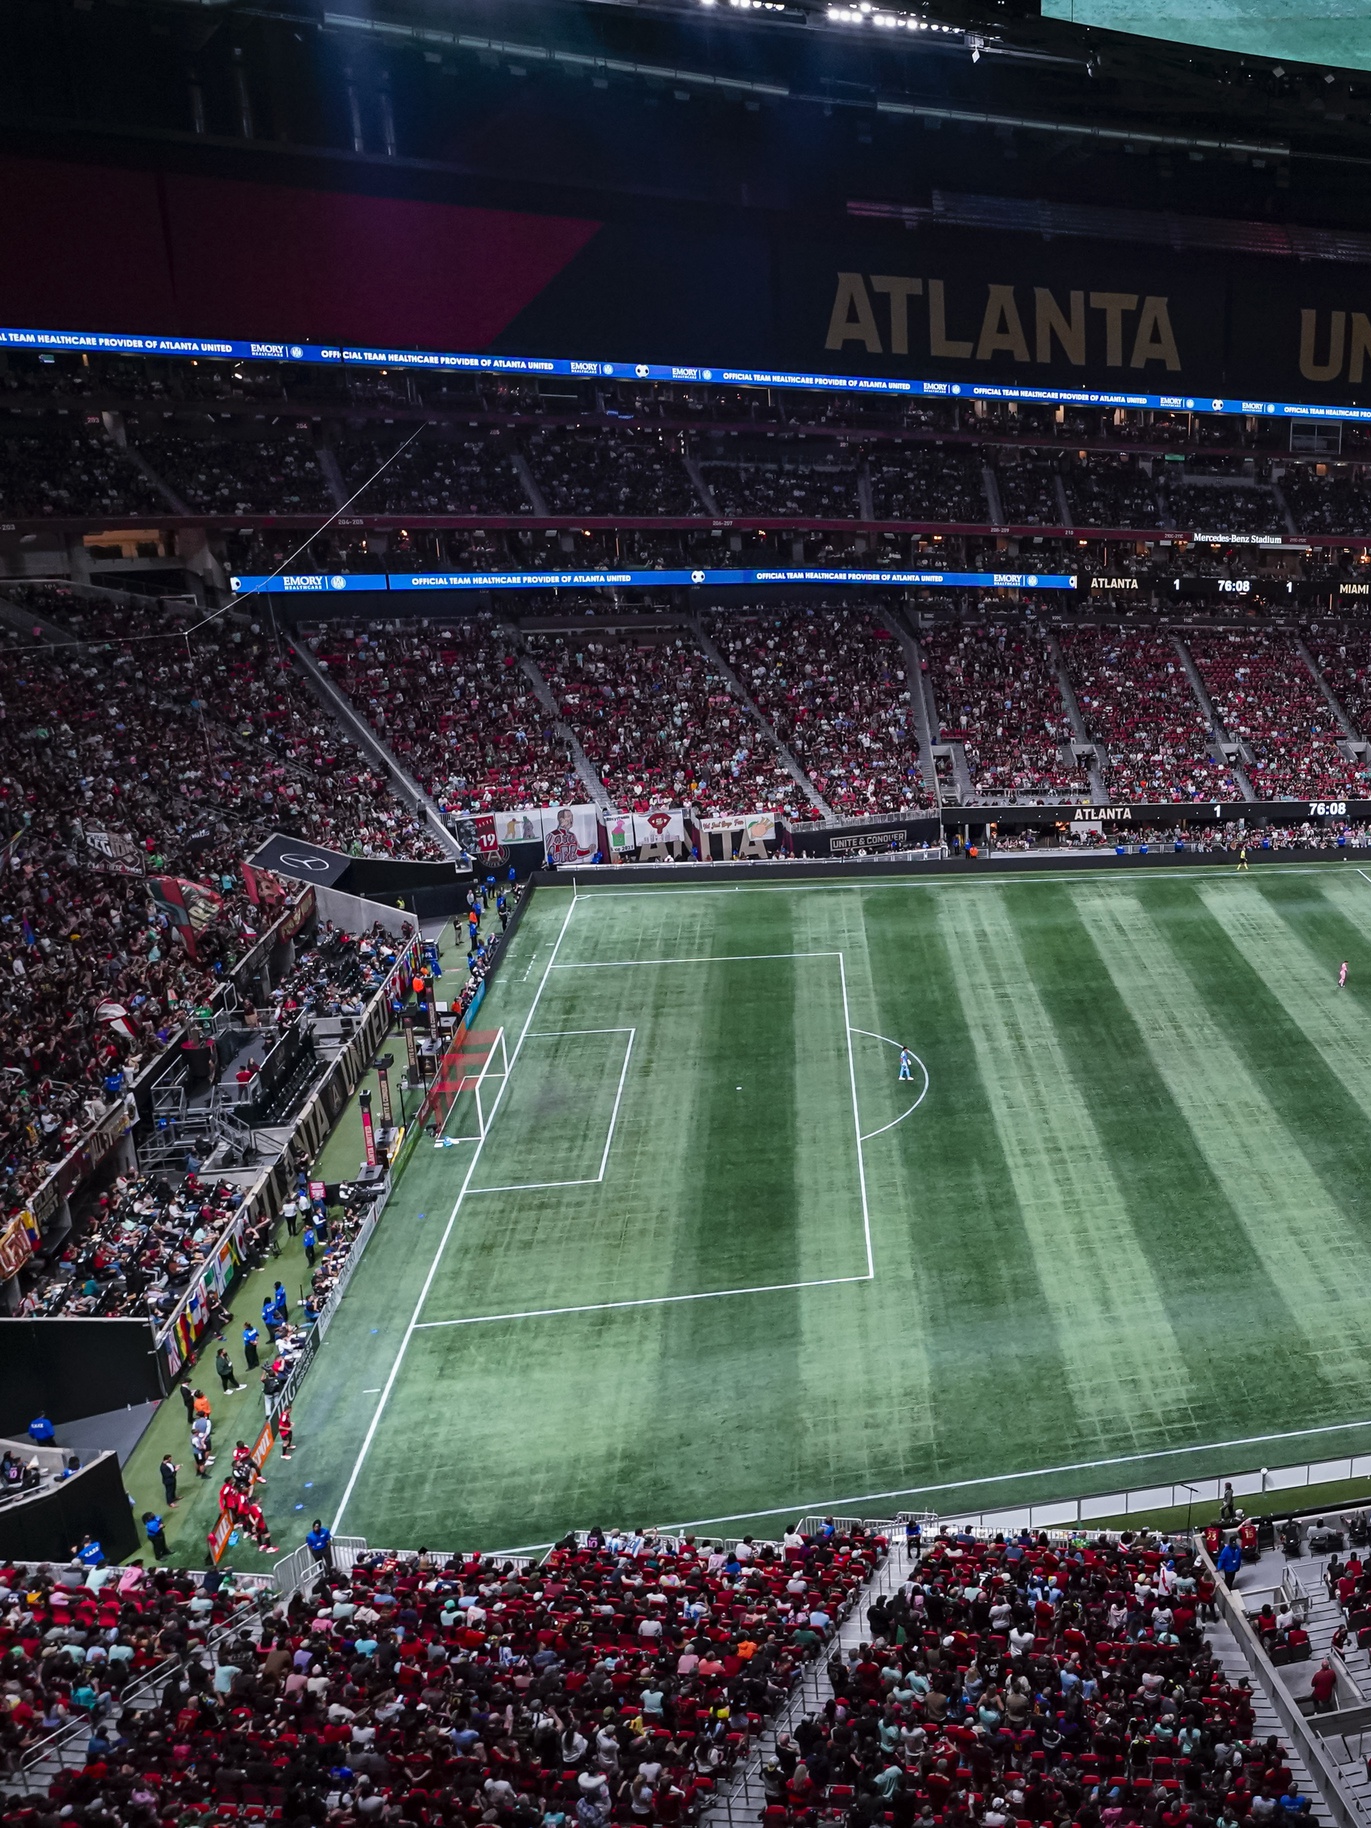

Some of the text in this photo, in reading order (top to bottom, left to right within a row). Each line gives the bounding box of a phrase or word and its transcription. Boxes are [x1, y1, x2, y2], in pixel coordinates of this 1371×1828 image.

[825, 272, 1181, 371] ATLANTA
[9, 333, 36, 343] TEAM
[38, 334, 97, 346] HEALTHCARE
[99, 338, 143, 348] PROVIDER
[145, 340, 157, 348] OF
[160, 341, 198, 351] ATLANTA
[202, 343, 232, 353] UNITED
[250, 344, 284, 354] EMORY
[321, 349, 553, 370] OFFICIAL TEAM HEALTHCARE PROVIDER OF ATLANTA UNITED
[571, 362, 597, 371] EMORY
[672, 368, 697, 376] EMORY
[723, 372, 910, 390] OFFICIAL TEAM HEALTHCARE PROVIDER OF ATLANTA UNITED
[924, 382, 947, 391] EMORY
[974, 387, 1147, 405] OFFICIAL TEAM HEALTHCARE PROVIDER OF ATLANTA UNITED
[1161, 397, 1182, 405] EMORY
[1242, 402, 1263, 410] EMORY
[1284, 406, 1308, 414] OFFICIAL
[1310, 407, 1324, 415] TEAM
[1326, 409, 1358, 417] HEALTHCARE
[1193, 533, 1249, 543] Mercedes-Benz
[1251, 535, 1282, 544] Stadium
[283, 576, 322, 585] EMORY
[412, 574, 630, 585] OFFICIAL TEAM HEALTHCARE PROVIDER OF ATLANTA UNITED
[757, 572, 785, 580] OFFICIAL
[787, 572, 804, 580] TEAM
[805, 572, 847, 580] HEALTHCARE
[848, 573, 880, 581] PROVIDER
[892, 574, 919, 582] ATLANTA
[921, 575, 942, 583] UNITED
[993, 574, 1022, 583] EMORY
[1091, 578, 1369, 594] ATLANTA 1 76:08 1 MIAMI
[1074, 807, 1132, 820] ATLANTA
[1214, 804, 1221, 817] 1
[1309, 803, 1346, 815] 76:08
[480, 834, 496, 847] 19
[832, 838, 857, 849] UNITE
[866, 833, 905, 846] CONQUER
[277, 1382, 297, 1415] IHG
